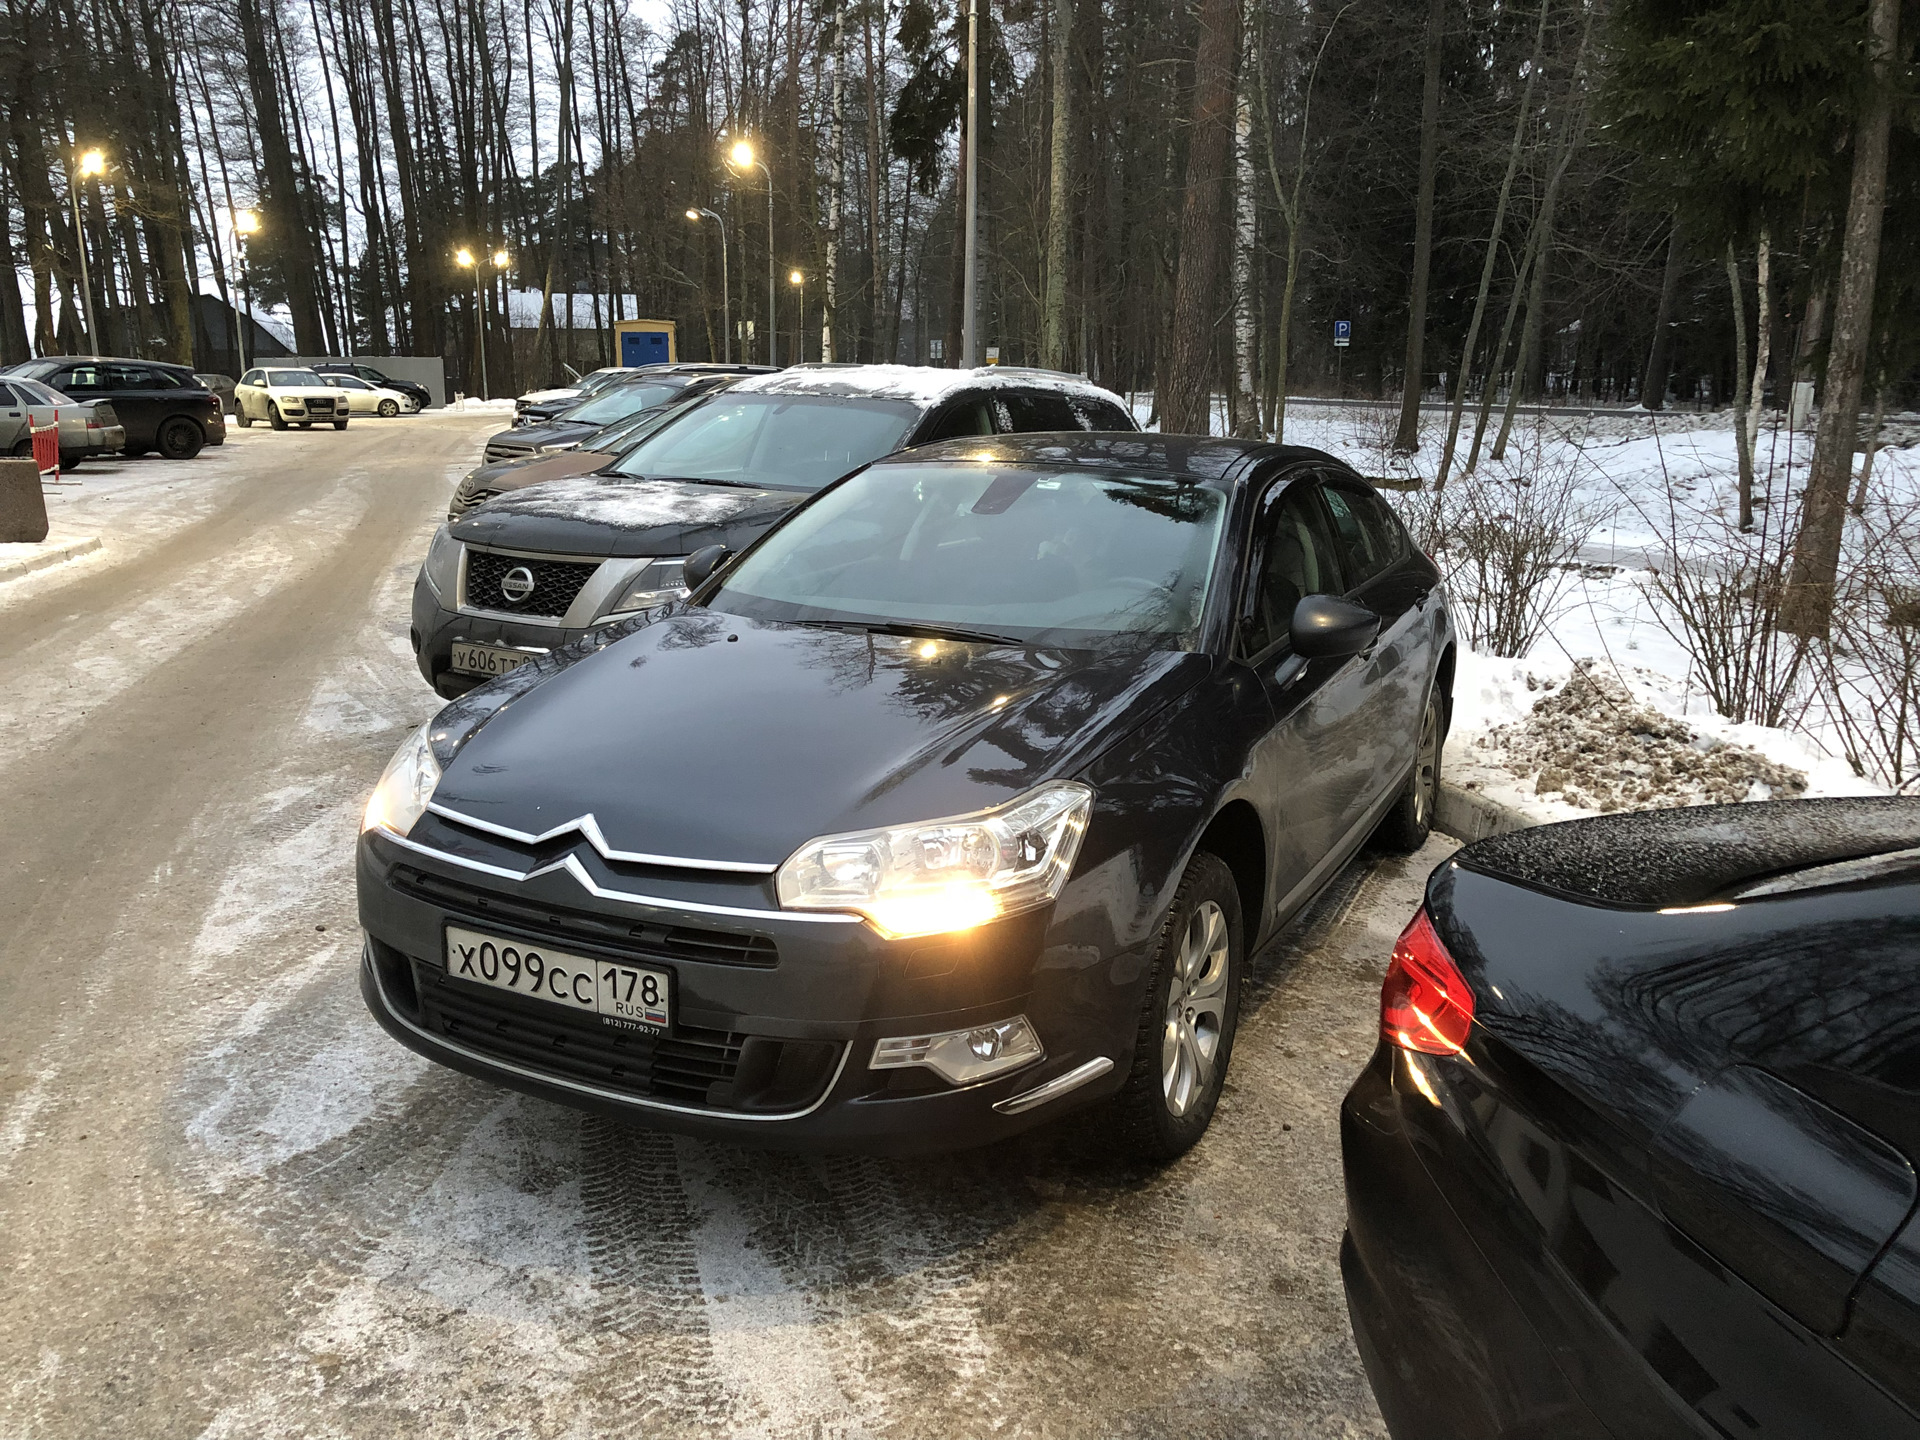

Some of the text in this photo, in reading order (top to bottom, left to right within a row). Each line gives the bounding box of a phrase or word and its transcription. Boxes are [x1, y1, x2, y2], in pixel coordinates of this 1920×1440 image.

[1338, 323, 1348, 336] P
[502, 580, 529, 590] NISSAN
[602, 967, 660, 1007] 178
[615, 1001, 644, 1019] RUS
[602, 1016, 660, 1036] (812) 777-92-77
